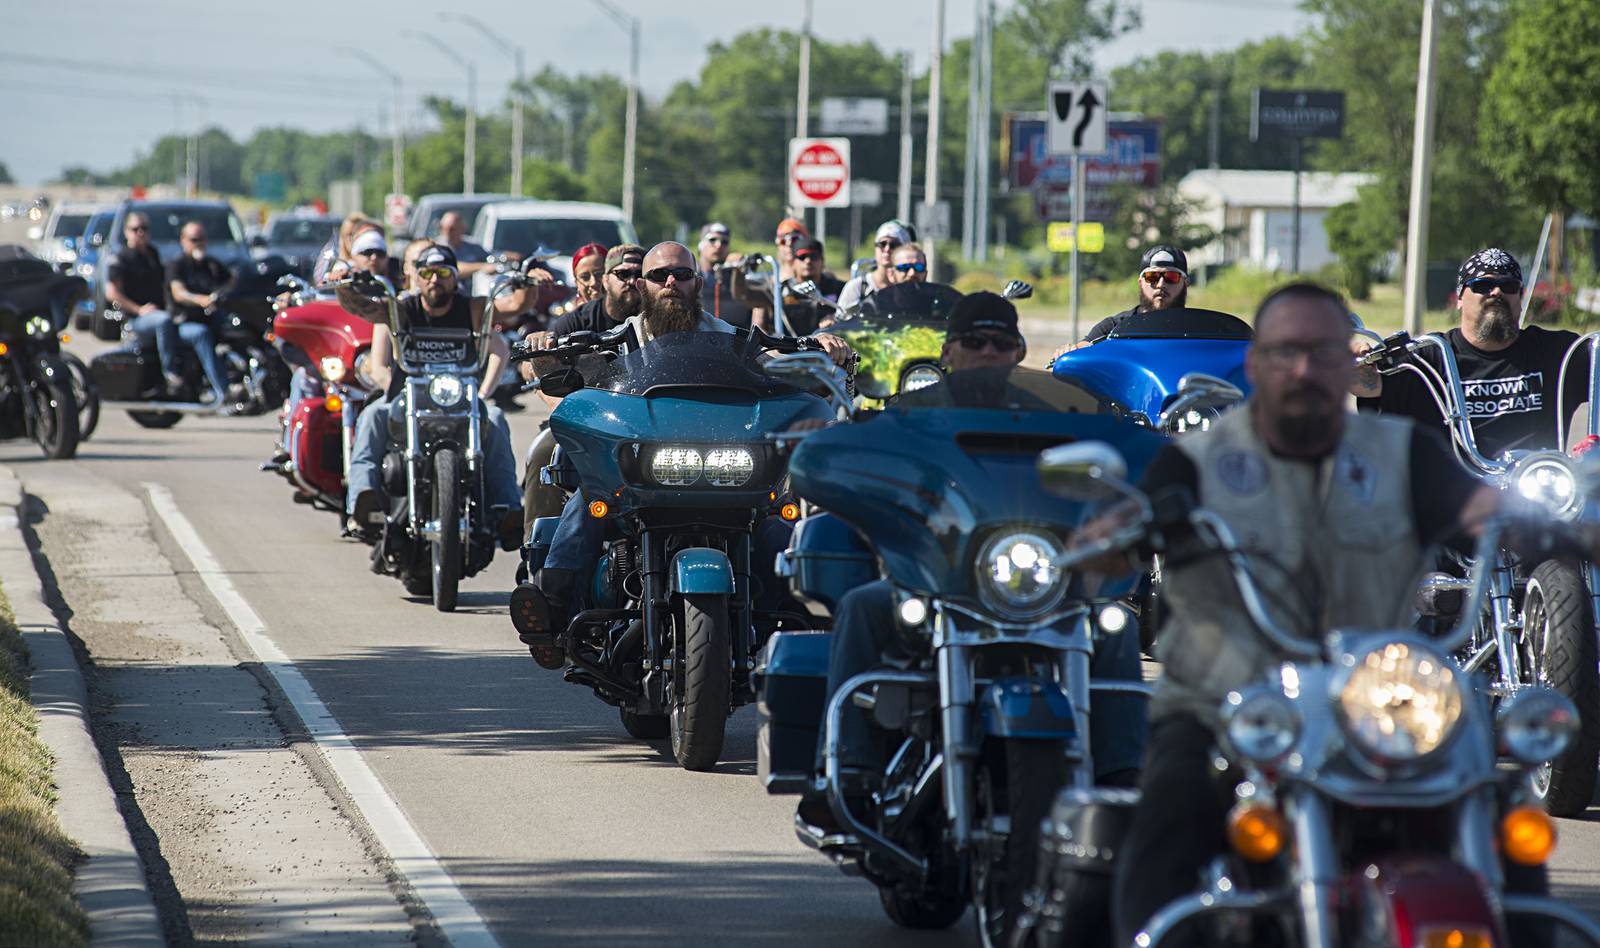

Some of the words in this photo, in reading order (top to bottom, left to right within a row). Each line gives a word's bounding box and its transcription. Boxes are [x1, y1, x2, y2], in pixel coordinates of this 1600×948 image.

[404, 349, 465, 361] ASSOCATE
[1465, 381, 1528, 397] KNOWN
[1464, 393, 1542, 413] SSOCIATE
